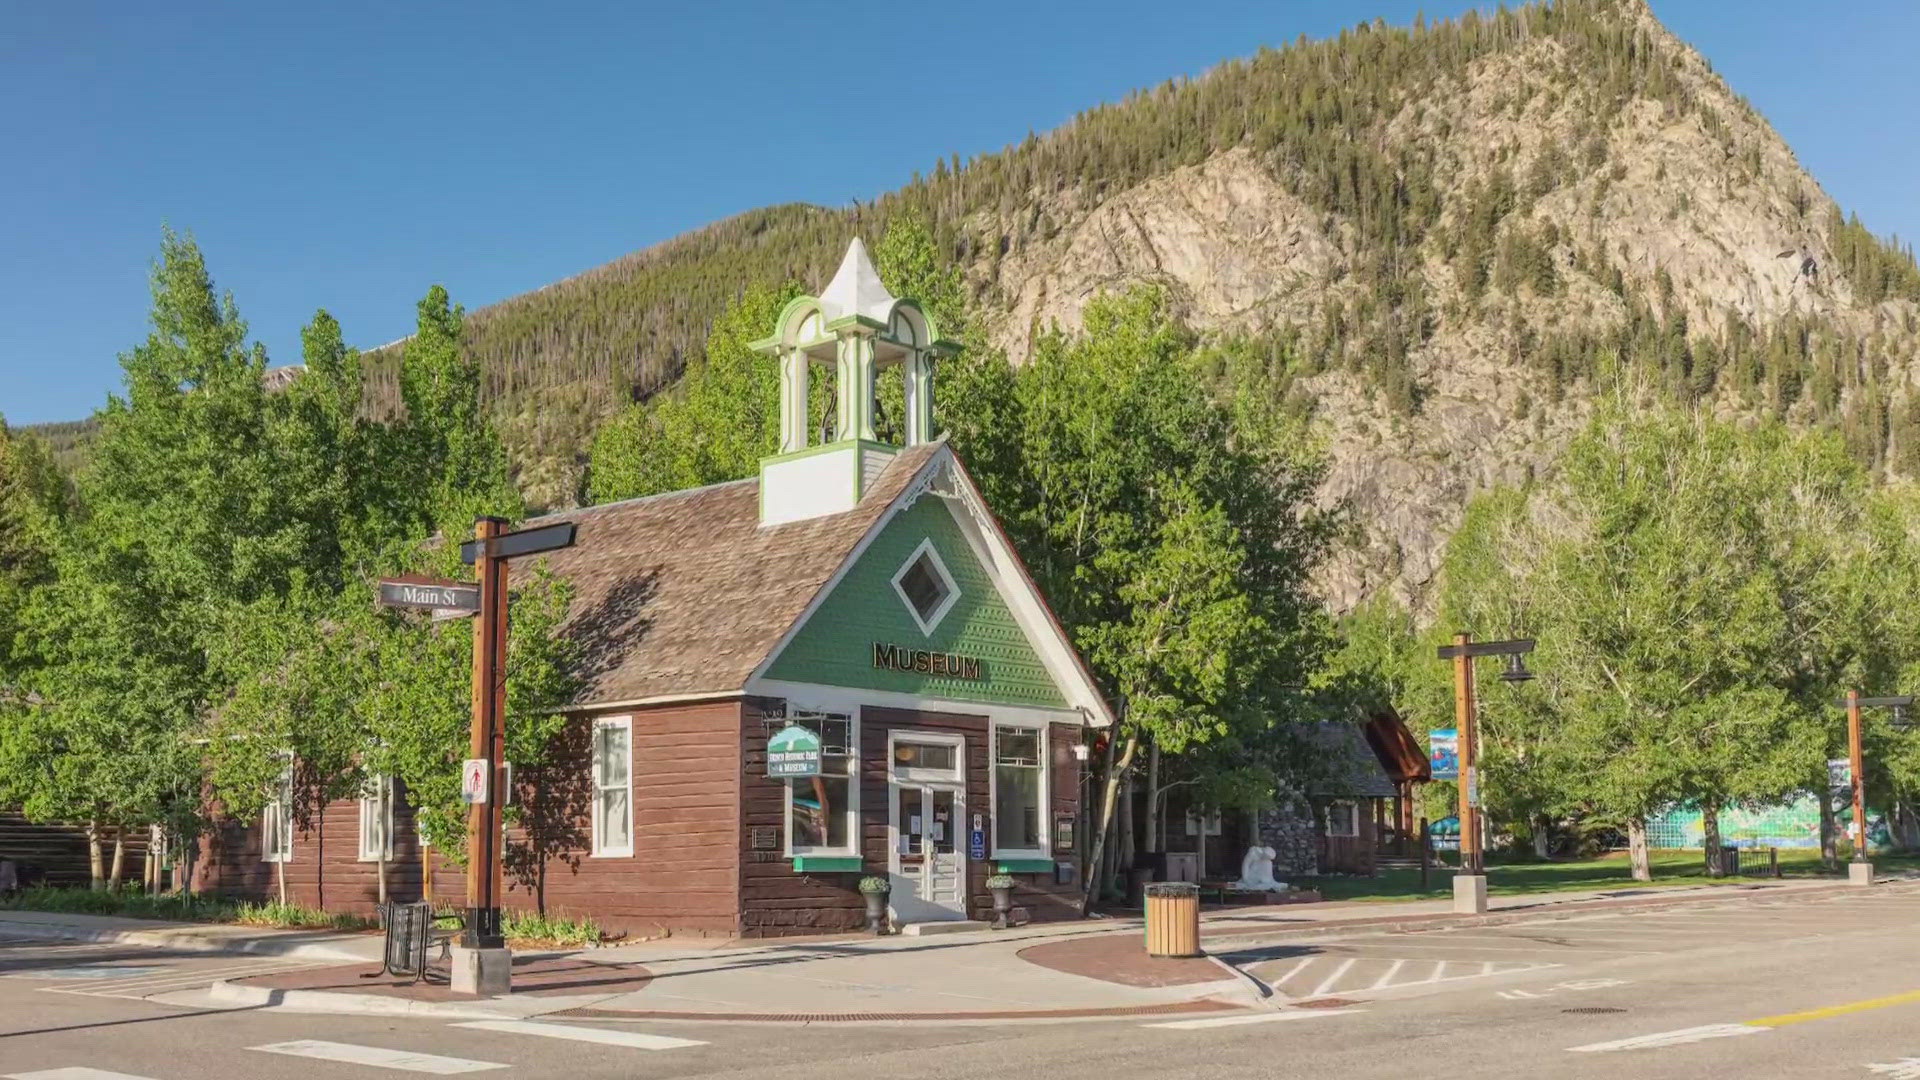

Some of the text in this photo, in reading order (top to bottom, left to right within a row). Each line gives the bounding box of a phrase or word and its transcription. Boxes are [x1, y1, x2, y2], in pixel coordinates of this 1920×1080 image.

[403, 587, 456, 606] Main St
[872, 641, 980, 678] MUSEUM
